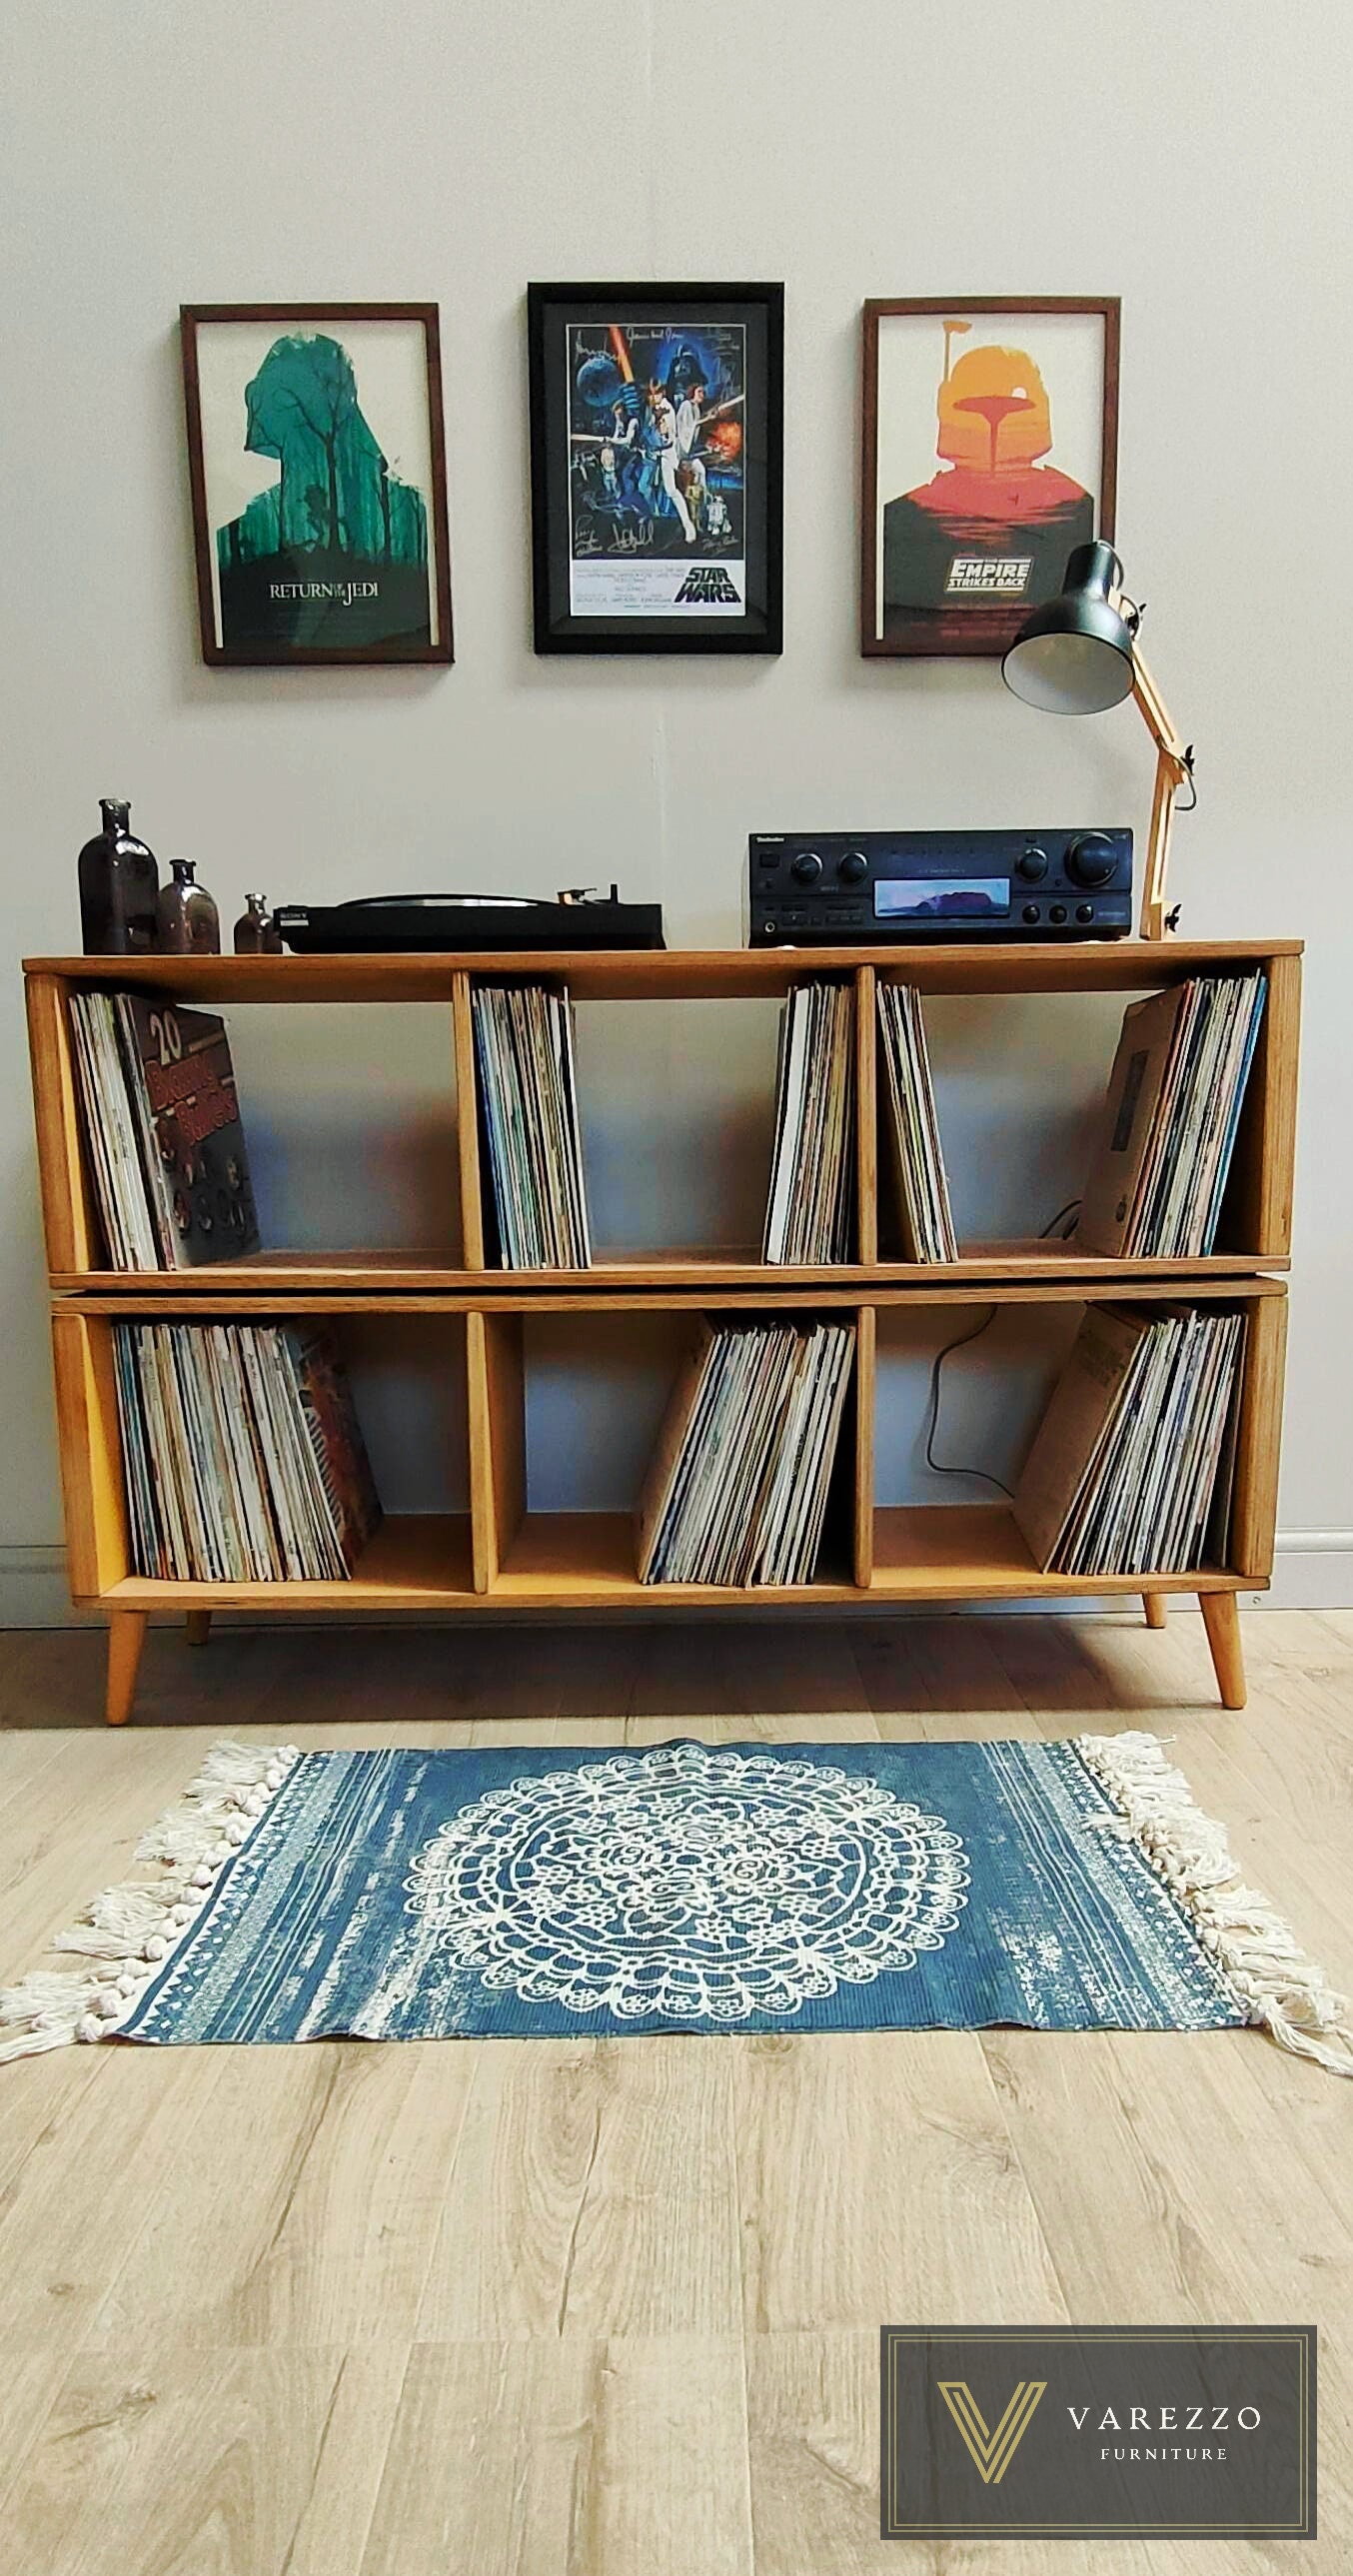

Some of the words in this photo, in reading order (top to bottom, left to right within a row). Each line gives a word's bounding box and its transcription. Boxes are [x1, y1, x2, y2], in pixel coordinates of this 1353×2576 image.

[685, 567, 730, 583] STAR
[950, 559, 1031, 578] EMPIRE
[270, 584, 334, 599] RETURN
[343, 583, 379, 606] JEDI
[674, 584, 741, 603] WARS
[150, 1009, 182, 1066] 20
